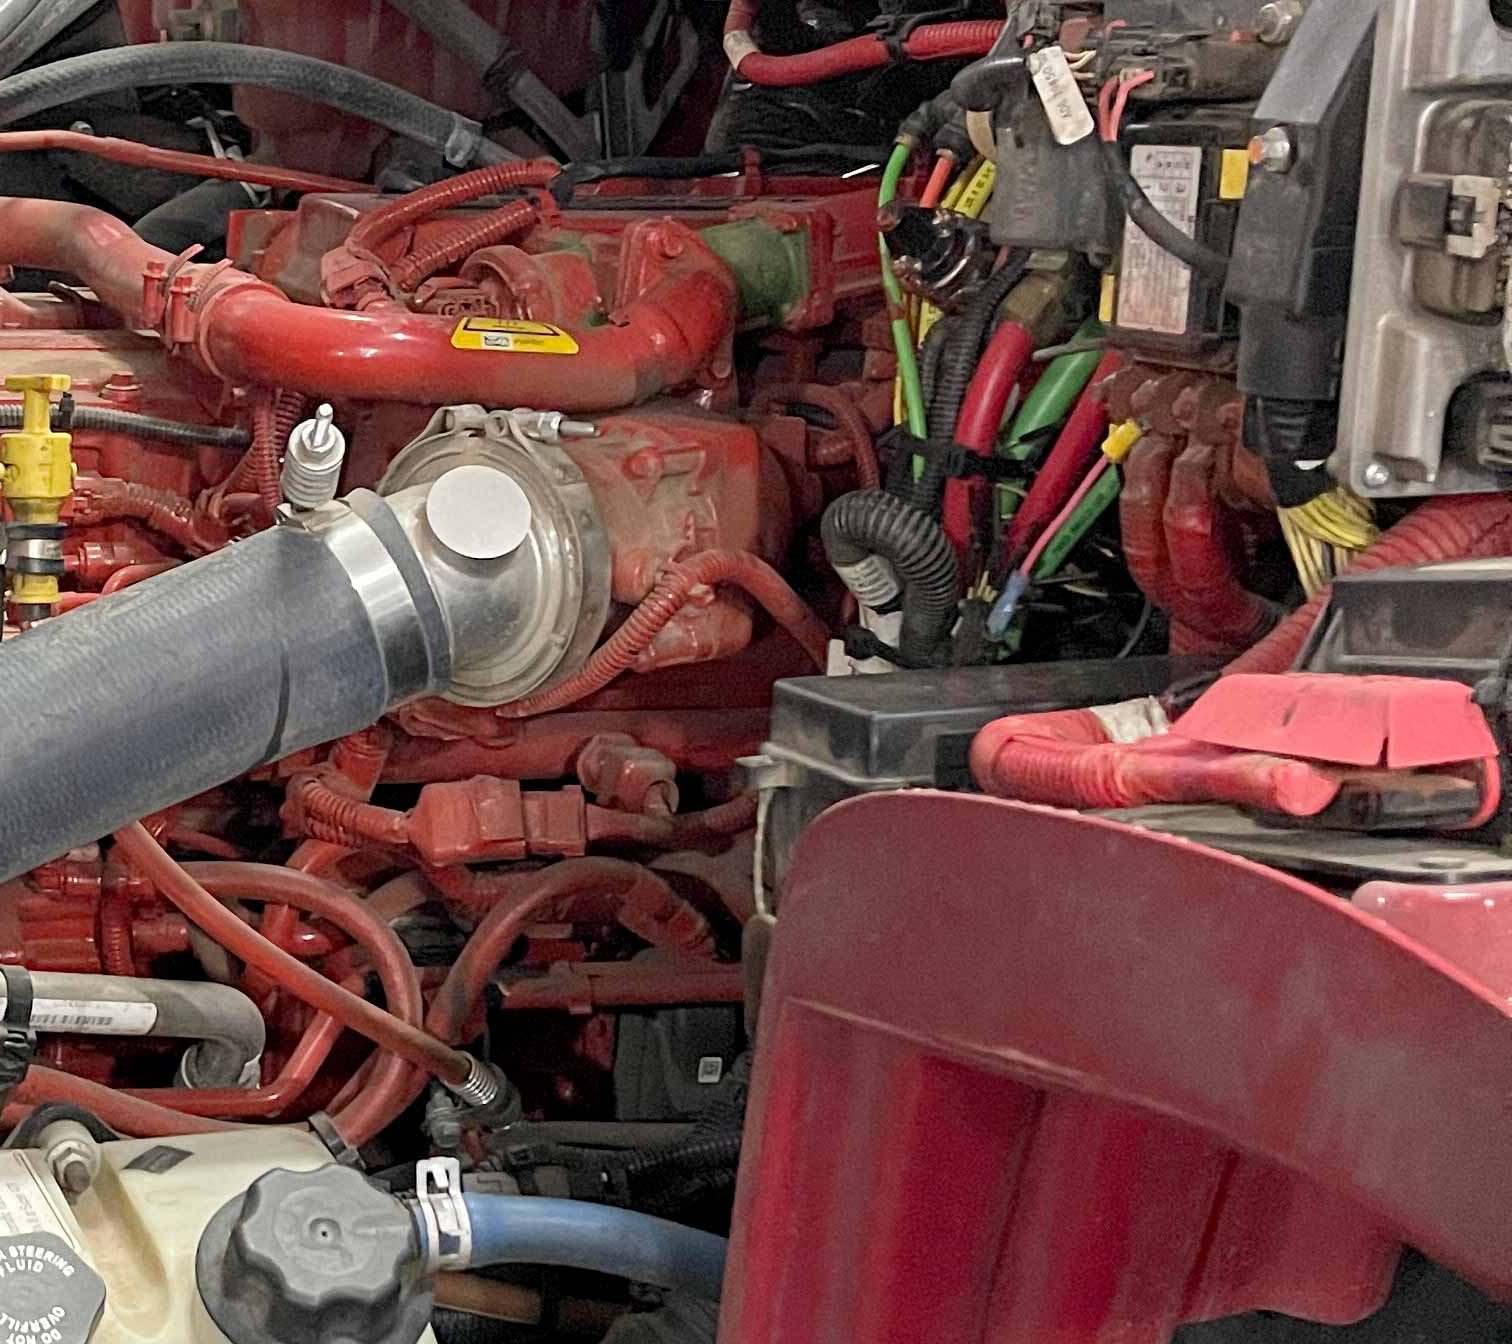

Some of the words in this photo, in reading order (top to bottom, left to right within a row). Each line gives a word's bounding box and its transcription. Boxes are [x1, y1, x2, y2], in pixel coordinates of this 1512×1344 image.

[8, 1245, 75, 1278] STEERING
[0, 1306, 66, 1334] OVERFILL
[40, 1327, 63, 1344] DO
